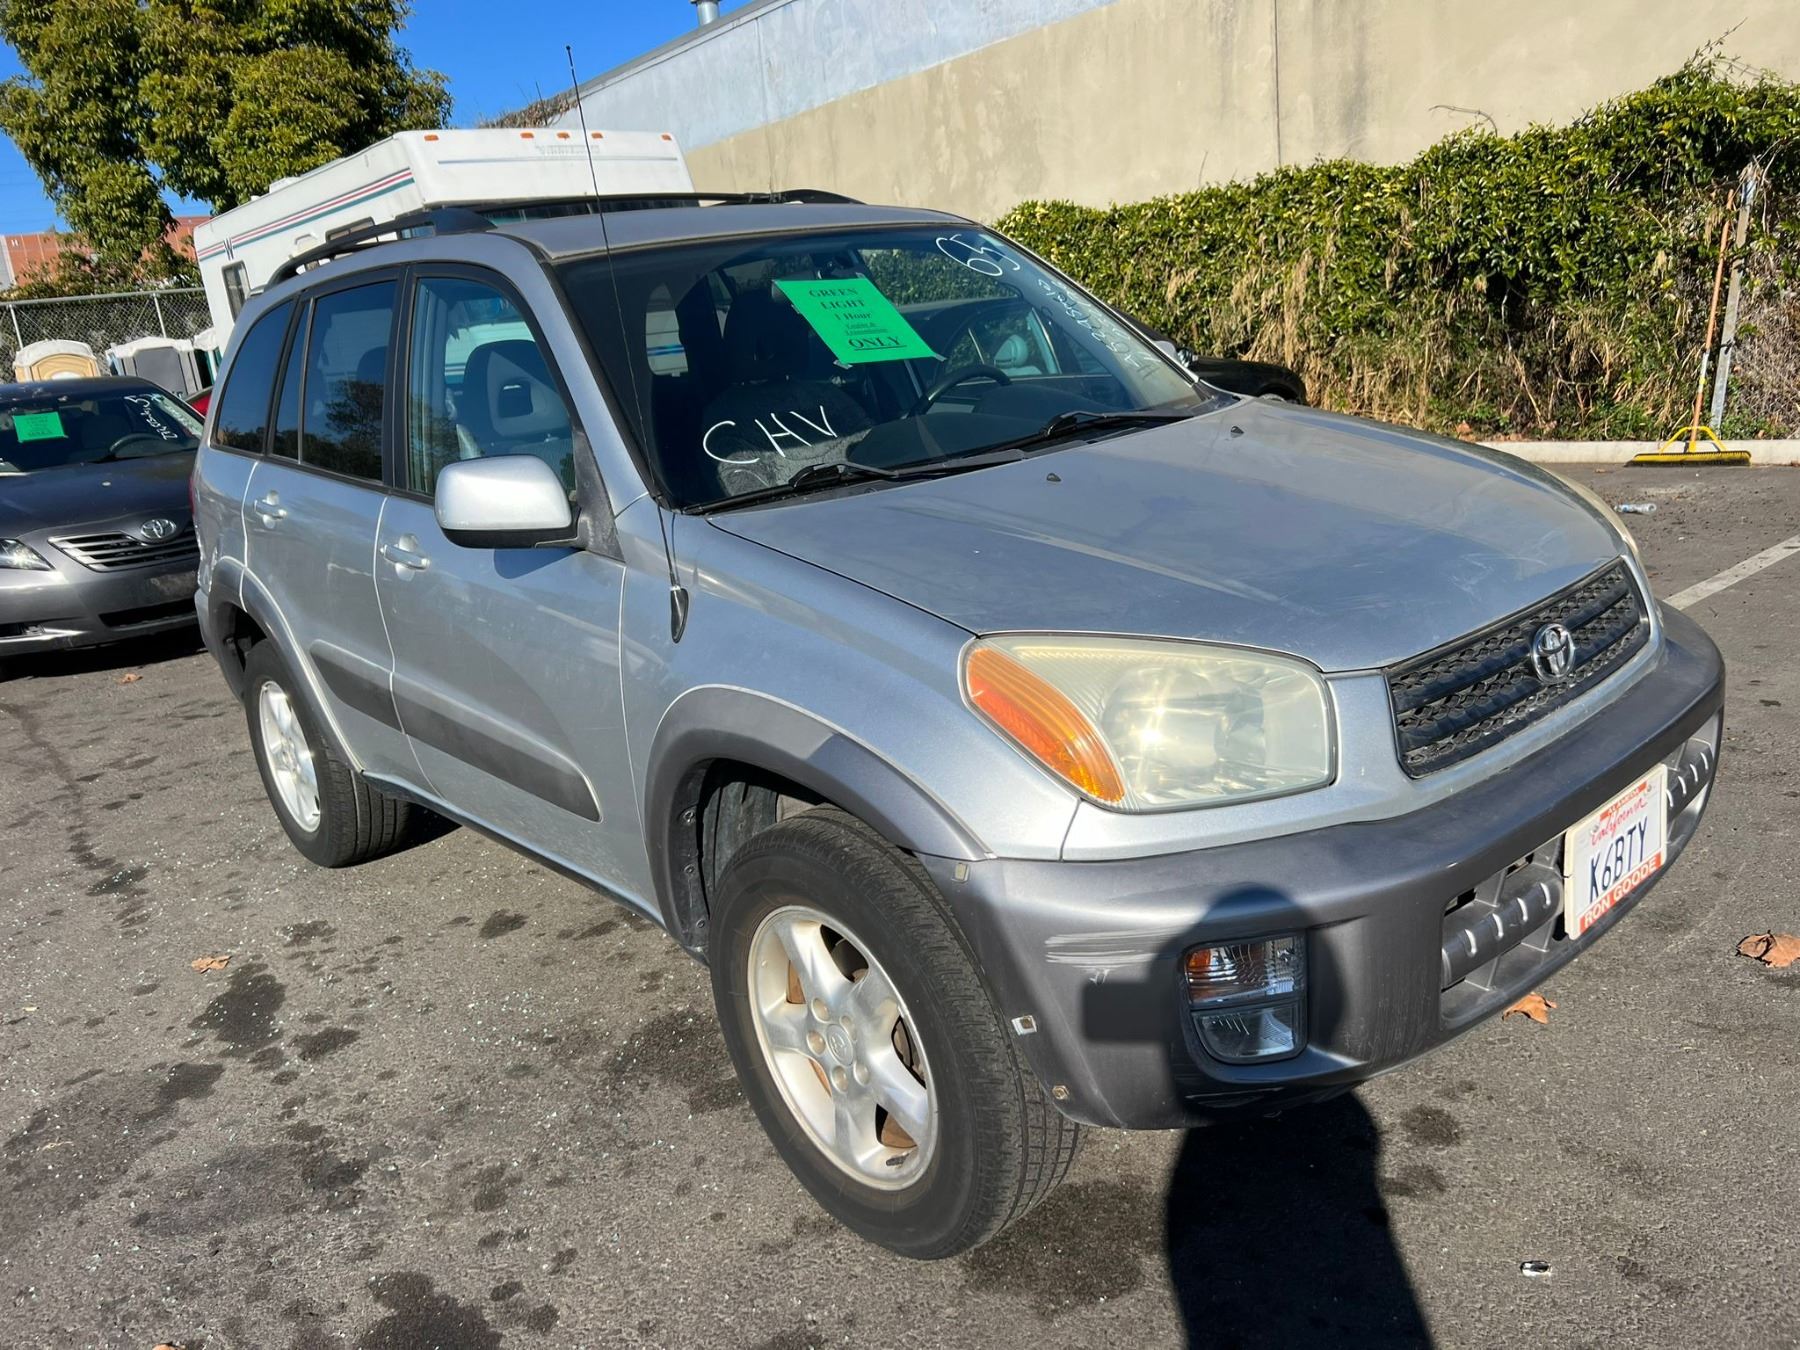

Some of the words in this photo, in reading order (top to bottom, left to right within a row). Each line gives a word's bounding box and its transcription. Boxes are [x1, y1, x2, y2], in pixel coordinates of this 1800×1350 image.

[809, 287, 858, 298] GREEN
[820, 299, 865, 310] LIGHT
[843, 312, 872, 320] Hour
[848, 335, 901, 349] ONLY
[703, 405, 838, 464] CHV
[1589, 816, 1648, 904] K6BTY
[1584, 894, 1611, 927] RON
[1613, 857, 1657, 901] GOODE
